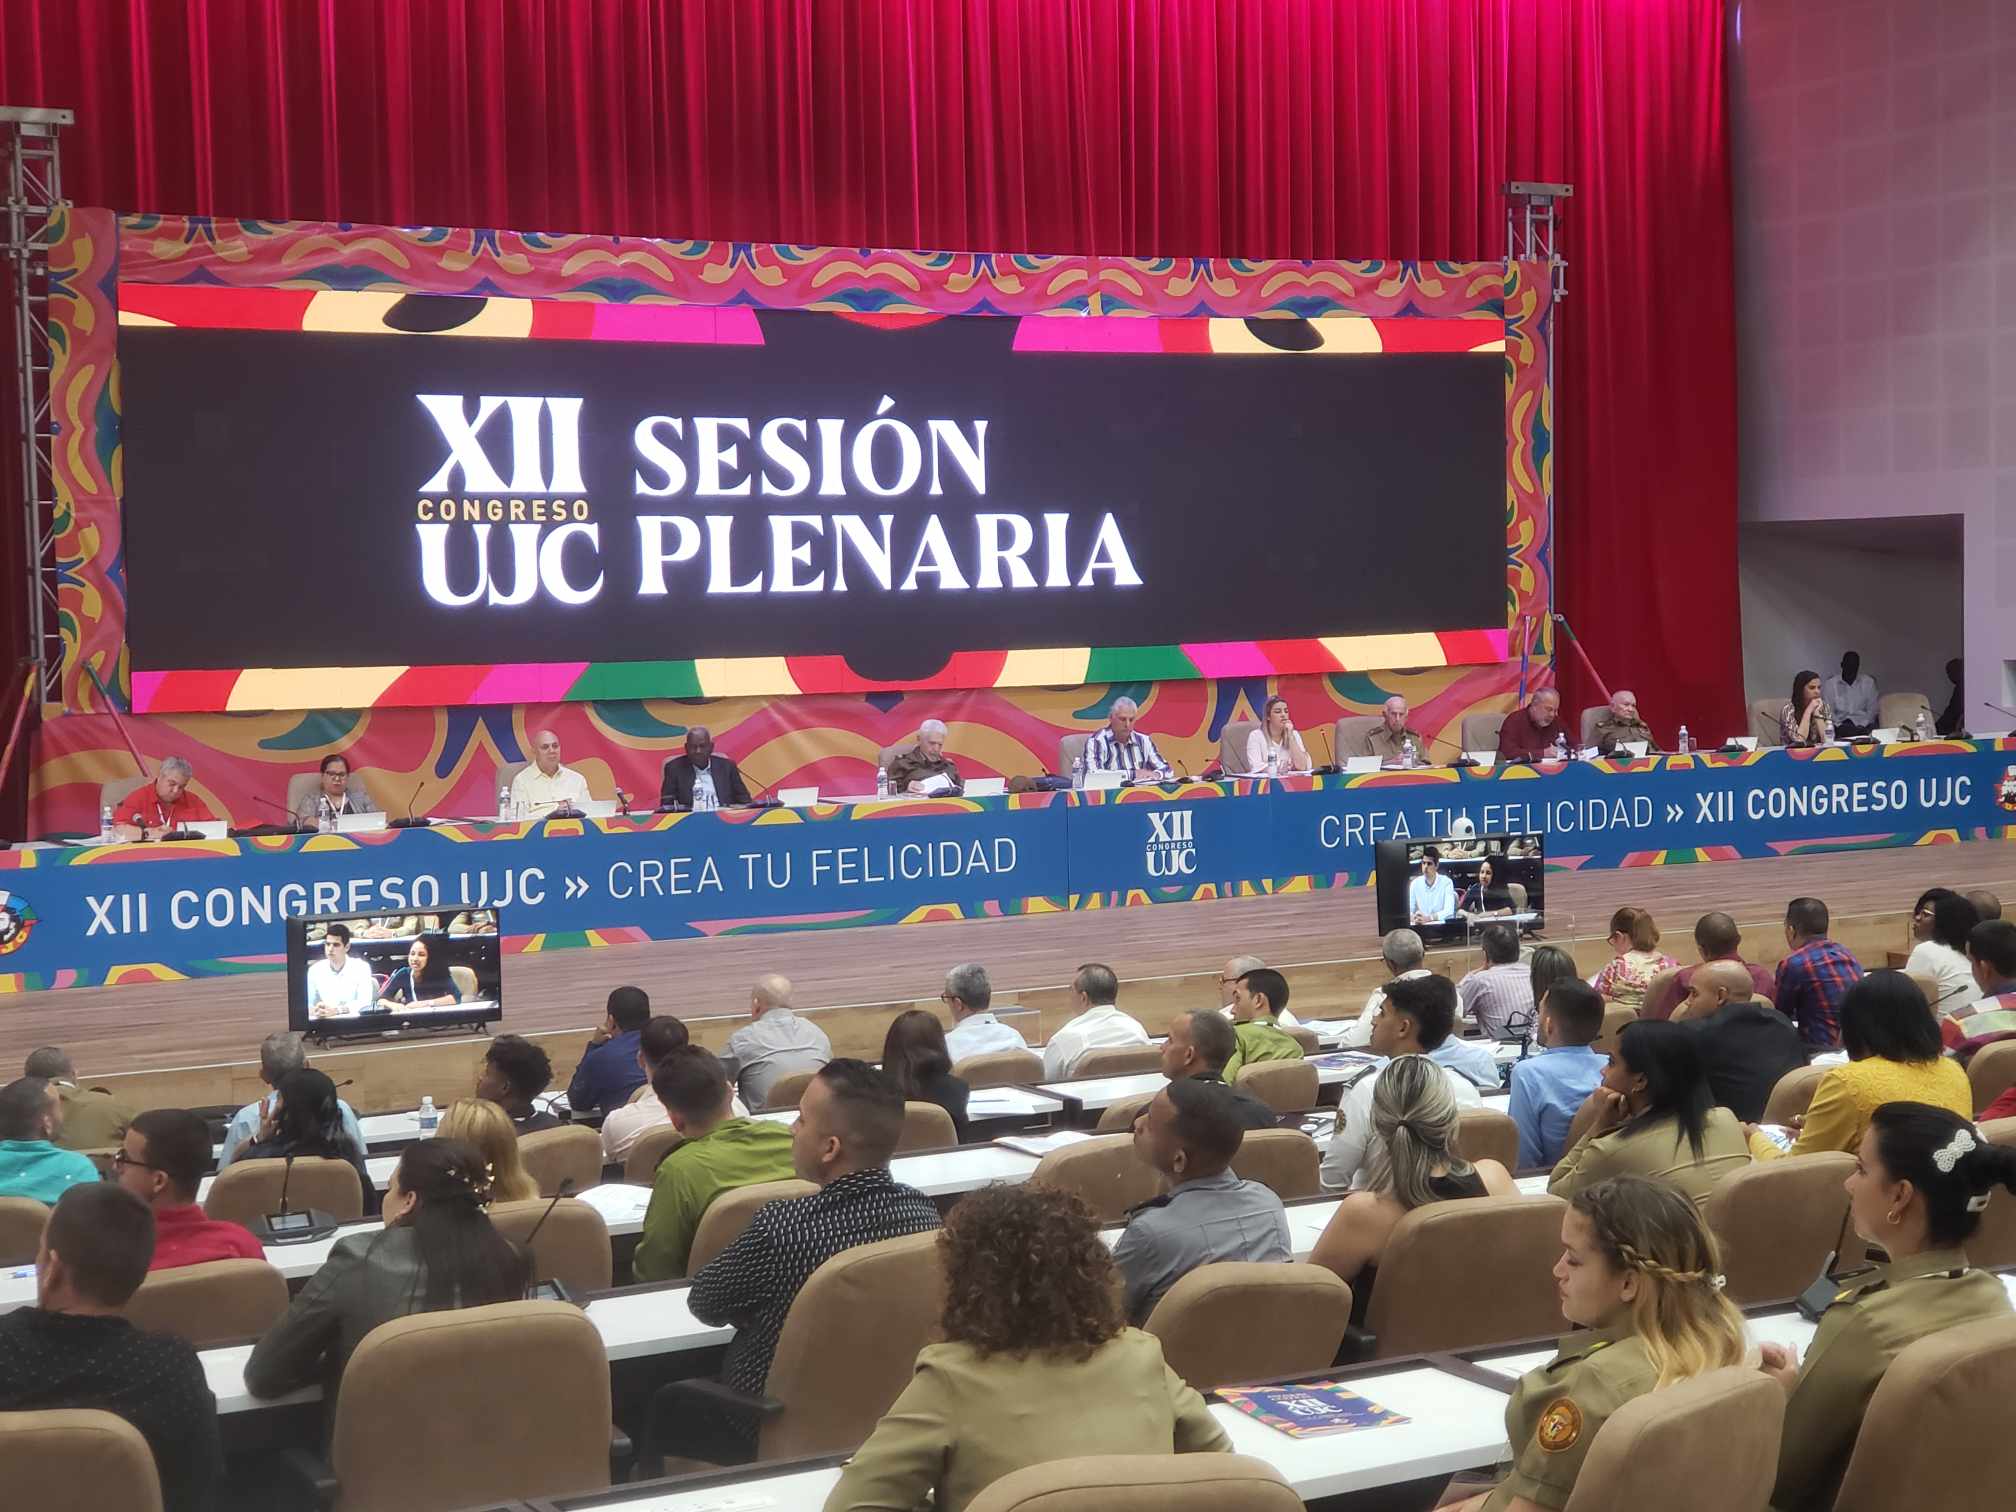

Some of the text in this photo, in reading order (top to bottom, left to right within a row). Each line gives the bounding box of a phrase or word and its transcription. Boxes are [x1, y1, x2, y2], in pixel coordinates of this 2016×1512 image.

[416, 394, 585, 493] XII
[633, 394, 989, 497] SESIÓN
[417, 498, 590, 522] CONGRESO
[415, 521, 604, 606] UJC
[637, 511, 1144, 596] PLENARIA
[1146, 841, 1193, 851] CONGRESO
[1147, 810, 1193, 843] XII
[1320, 811, 1411, 848] CREA
[1483, 797, 1653, 836] FELICIDAD
[1695, 791, 1734, 823] XII
[1747, 779, 1907, 820] CONGRESO
[1919, 776, 1972, 808] UJC
[85, 838, 1017, 936] XII CONGRESO UJC CREA TU FELICIDAD
[1146, 848, 1197, 876] UJC
